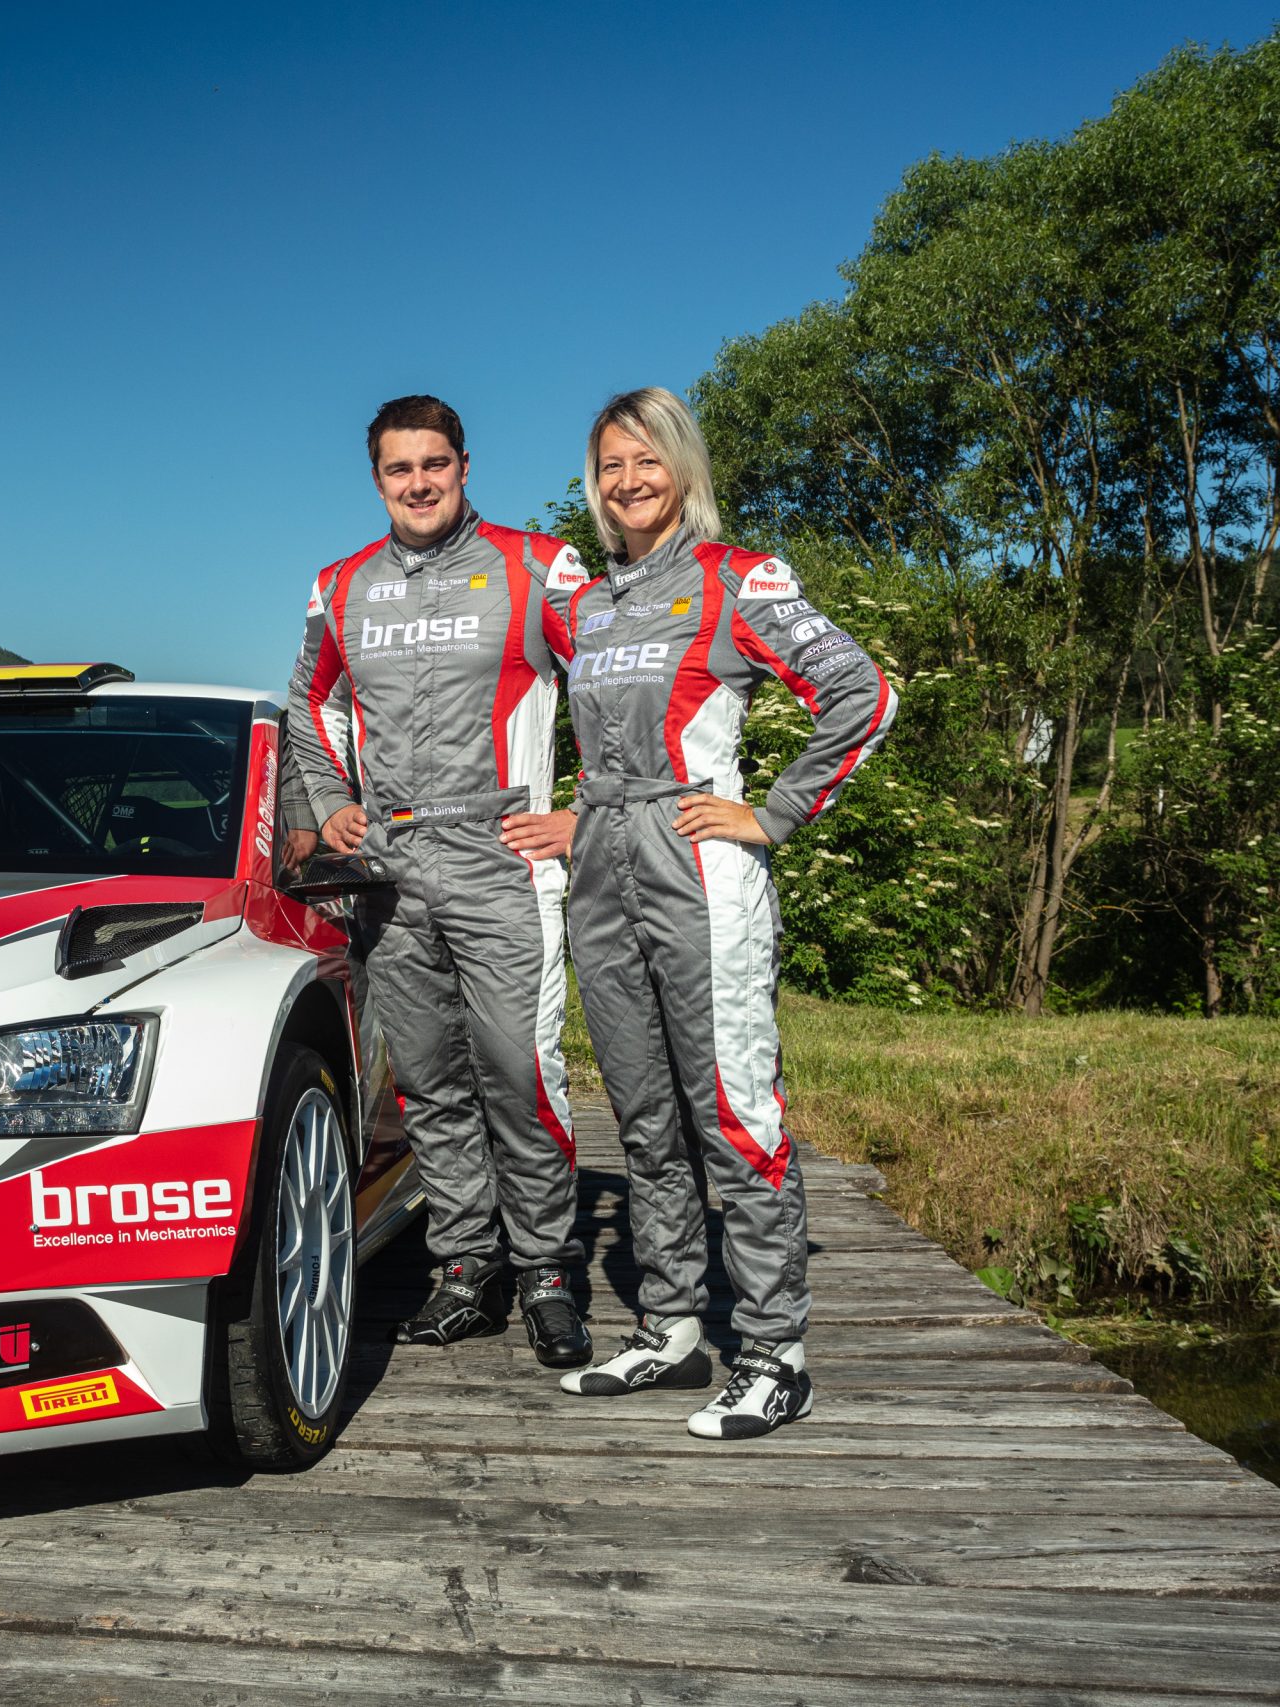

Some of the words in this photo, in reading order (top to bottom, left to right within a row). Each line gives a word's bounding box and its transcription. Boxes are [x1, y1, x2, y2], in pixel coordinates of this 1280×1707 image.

[405, 547, 438, 566] freem
[428, 579, 447, 587] ADAC
[558, 572, 585, 584] freem
[615, 565, 647, 586] freem
[749, 578, 789, 592] freem
[629, 604, 652, 613] ADAC
[652, 602, 671, 611] Team
[773, 600, 813, 619] bro
[361, 616, 479, 649] brose
[361, 648, 403, 660] Excellence
[405, 647, 414, 655] in
[417, 643, 479, 653] Mechatronics
[112, 806, 135, 816] OMP
[421, 807, 432, 817] D.
[434, 803, 466, 815] Dinkel
[30, 1170, 232, 1228] brose
[33, 1231, 114, 1248] Excellence
[119, 1230, 131, 1243] in
[135, 1225, 236, 1242] Mechatronics
[30, 1381, 110, 1413] PIRELLI
